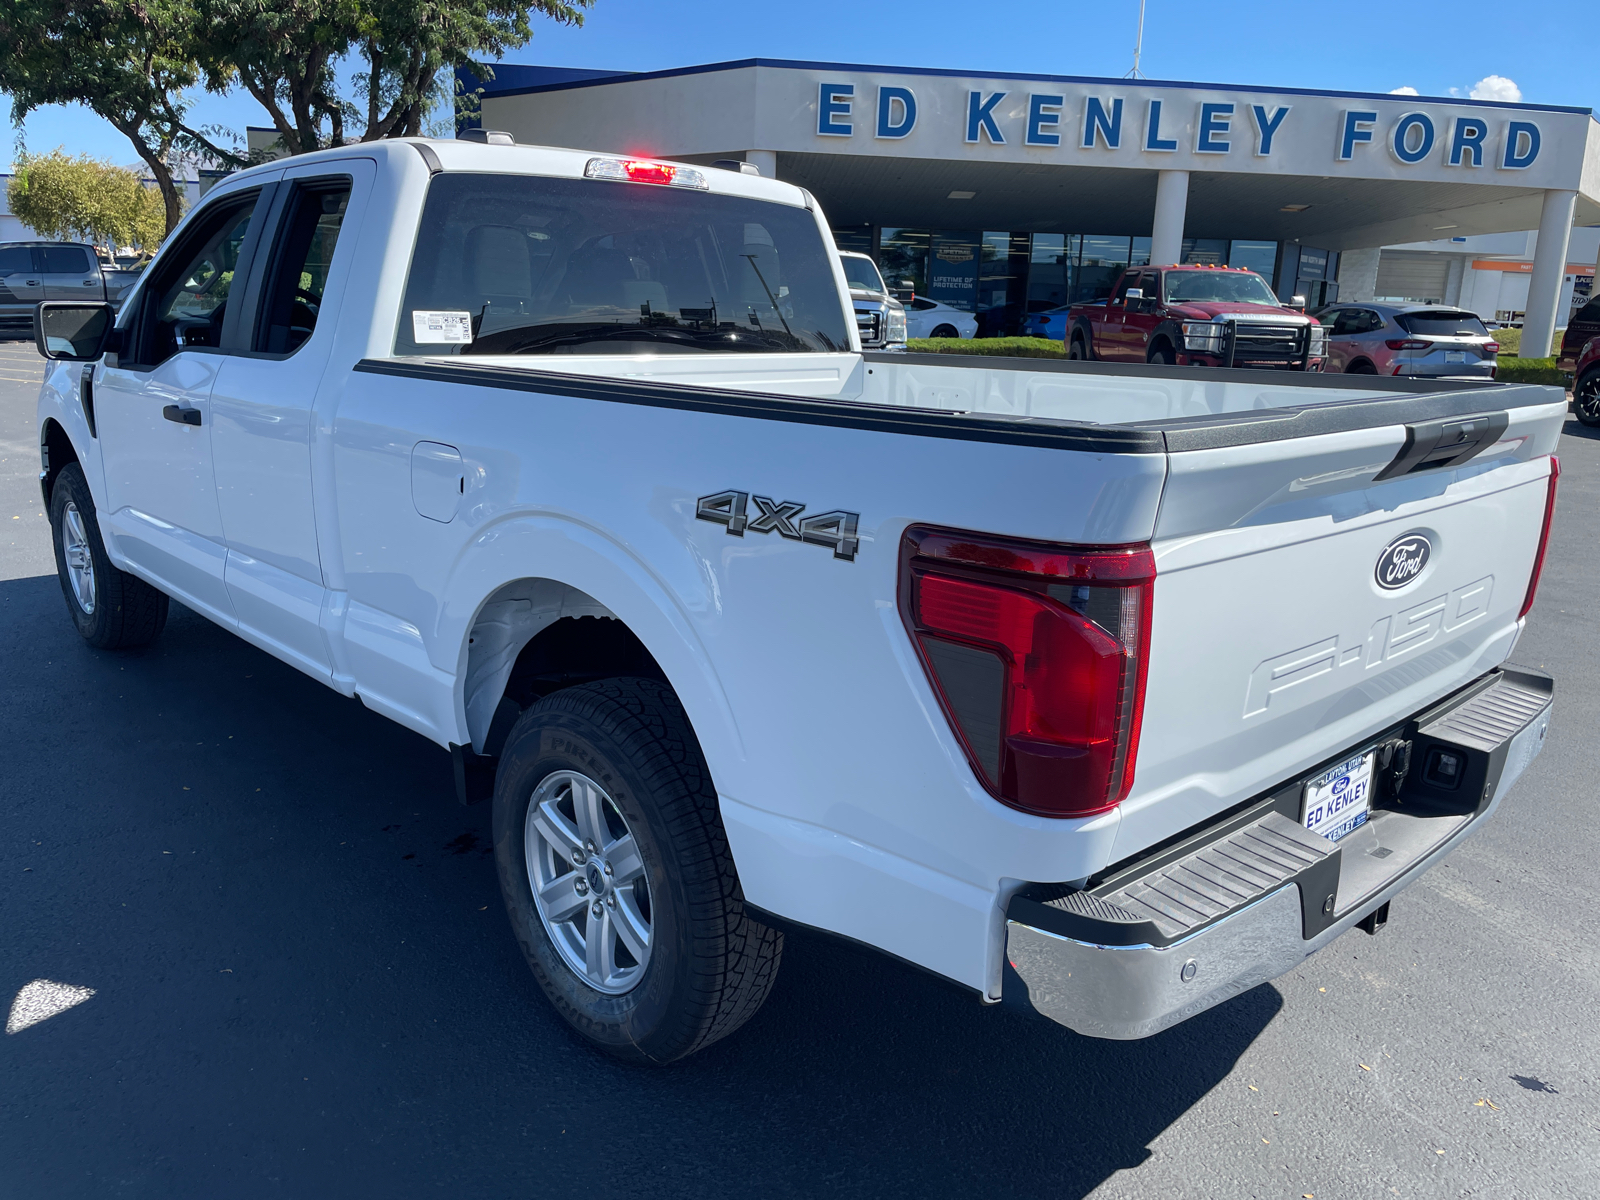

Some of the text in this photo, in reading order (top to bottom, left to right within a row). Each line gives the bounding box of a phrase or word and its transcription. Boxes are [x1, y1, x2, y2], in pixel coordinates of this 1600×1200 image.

[817, 82, 1542, 171] ED KENLEY FORD
[1385, 542, 1426, 583] Ford
[1242, 573, 1495, 719] F-150
[551, 737, 640, 822] PIRELLI
[1348, 755, 1362, 770] UTAH
[1307, 806, 1323, 829] ED
[1326, 779, 1368, 818] KENLEY
